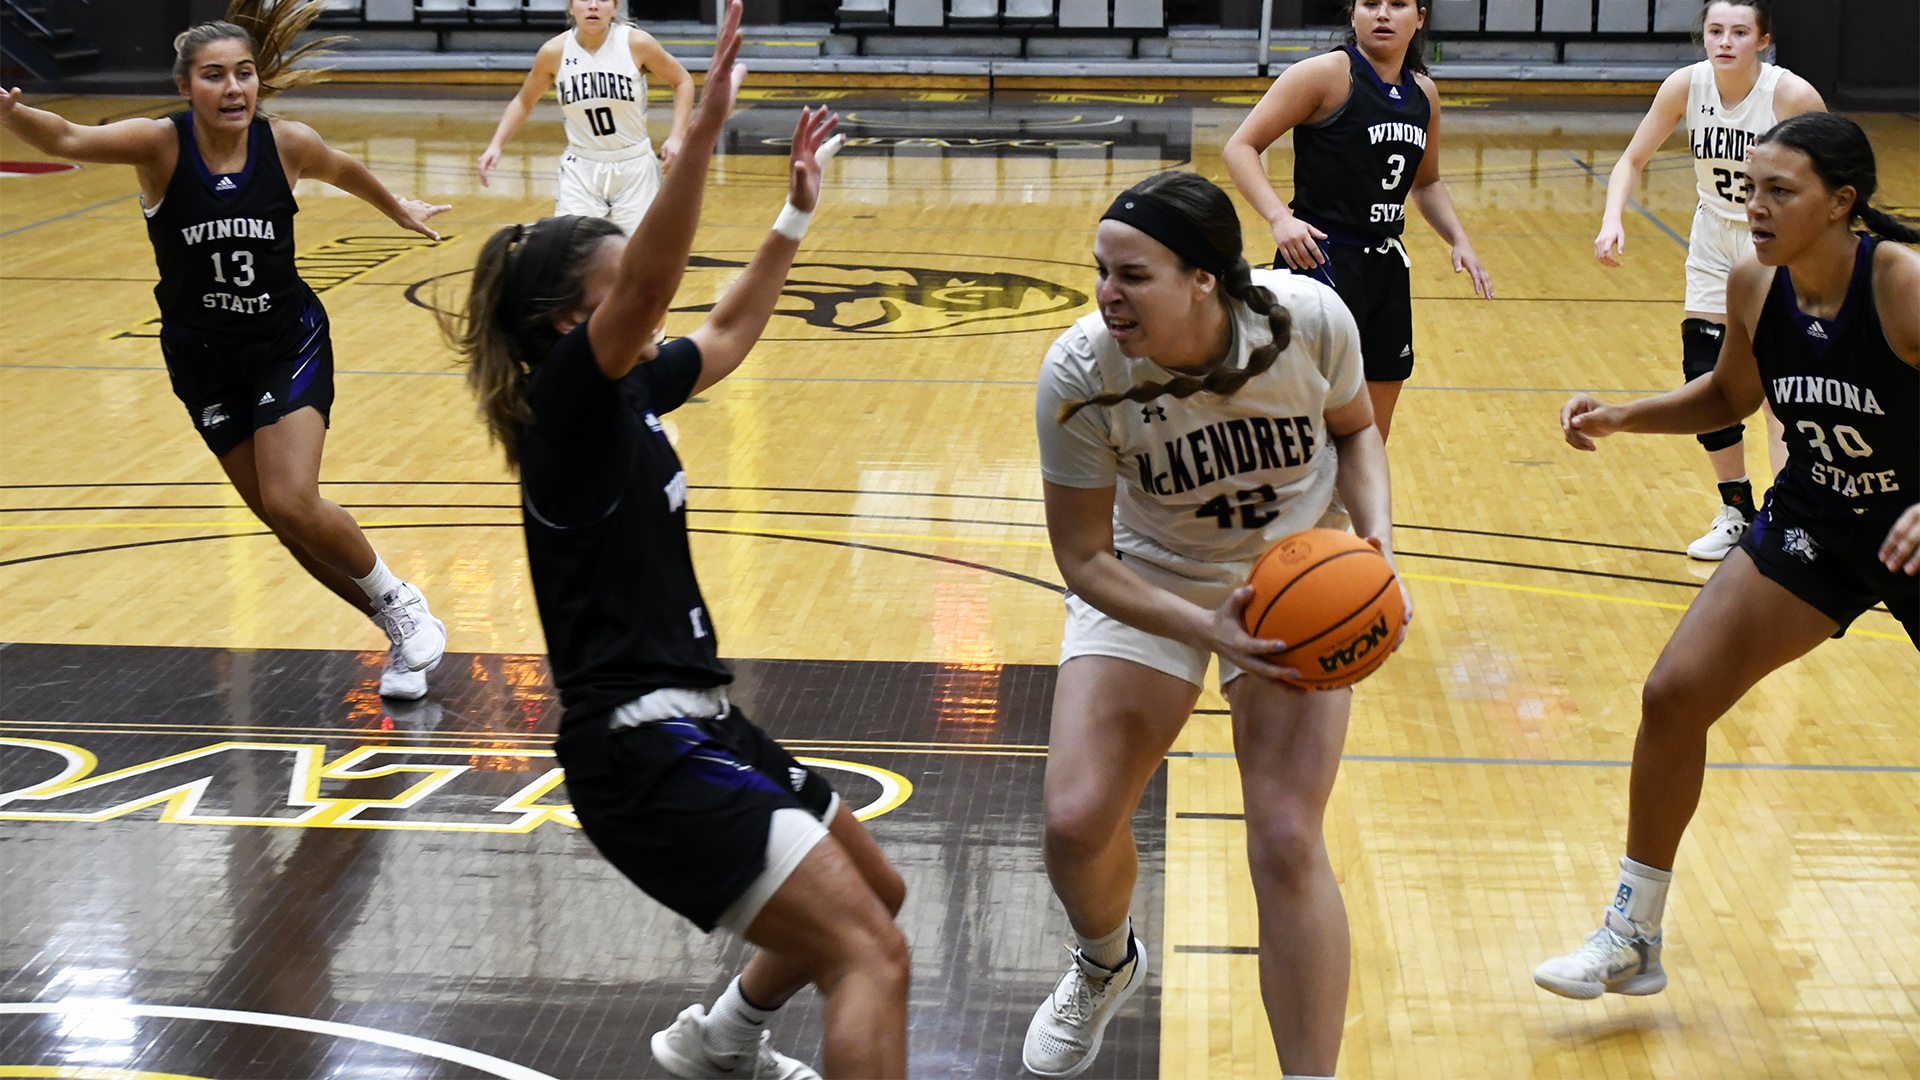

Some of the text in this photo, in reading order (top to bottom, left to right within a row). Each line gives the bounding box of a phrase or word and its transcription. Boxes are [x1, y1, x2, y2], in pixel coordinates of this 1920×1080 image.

[584, 106, 616, 136] 10
[1367, 122, 1427, 151] WINON
[1381, 153, 1406, 191] 3
[1713, 167, 1746, 204] 23
[181, 217, 276, 246] WINONA
[210, 250, 256, 288] 13
[202, 292, 272, 315] STATE
[1772, 375, 1885, 416] WINONA
[1134, 415, 1315, 496] McKENDREE
[1796, 419, 1874, 463] 30
[1811, 461, 1901, 498] STATE
[1195, 483, 1280, 530] 42
[1317, 614, 1390, 674] NCAA
